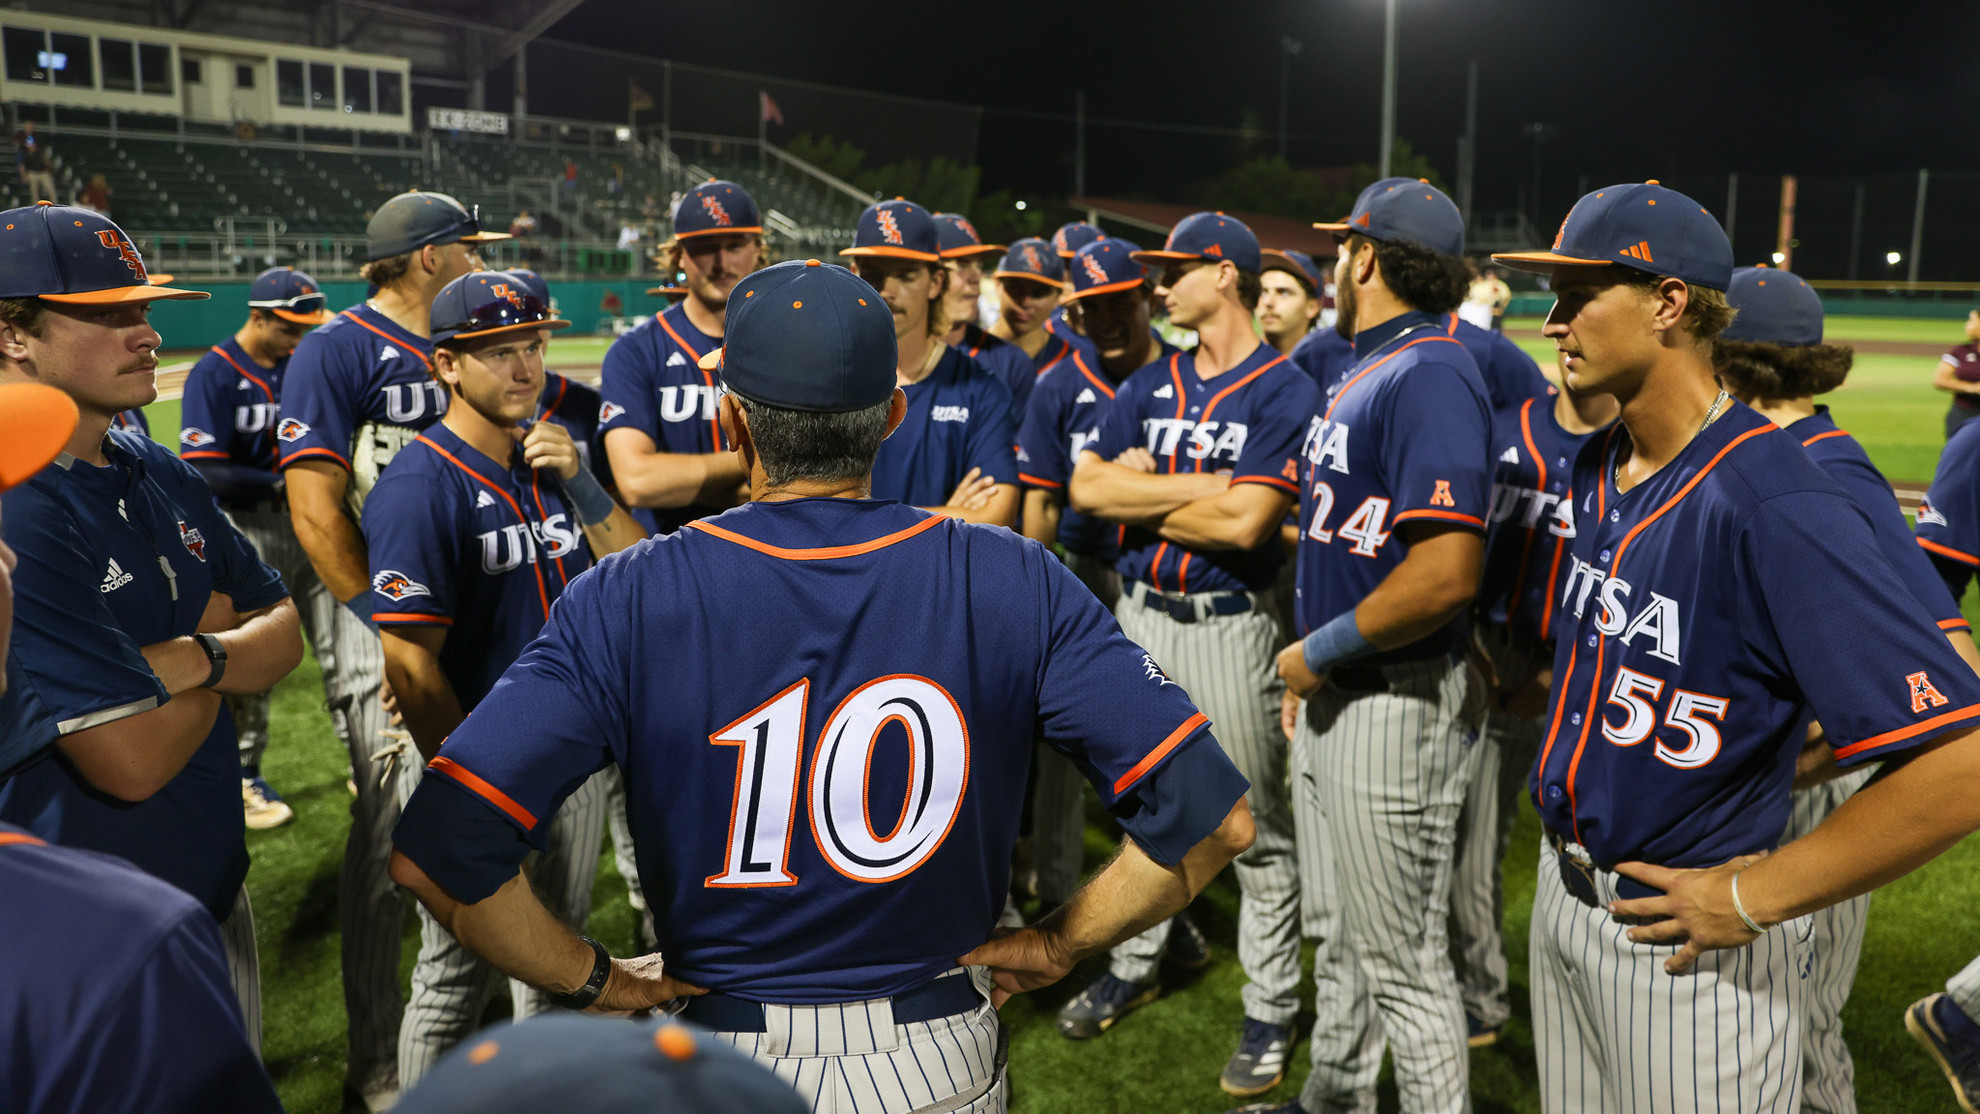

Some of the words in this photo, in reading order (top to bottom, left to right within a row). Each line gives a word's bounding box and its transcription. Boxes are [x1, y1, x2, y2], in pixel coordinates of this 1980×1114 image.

[94, 230, 148, 280] UTSA
[1307, 481, 1392, 559] 24
[1487, 483, 1577, 538] UTS
[100, 572, 134, 593] adidas
[1601, 665, 1730, 770] 55
[1905, 671, 1949, 714] A
[704, 673, 970, 888] 10
